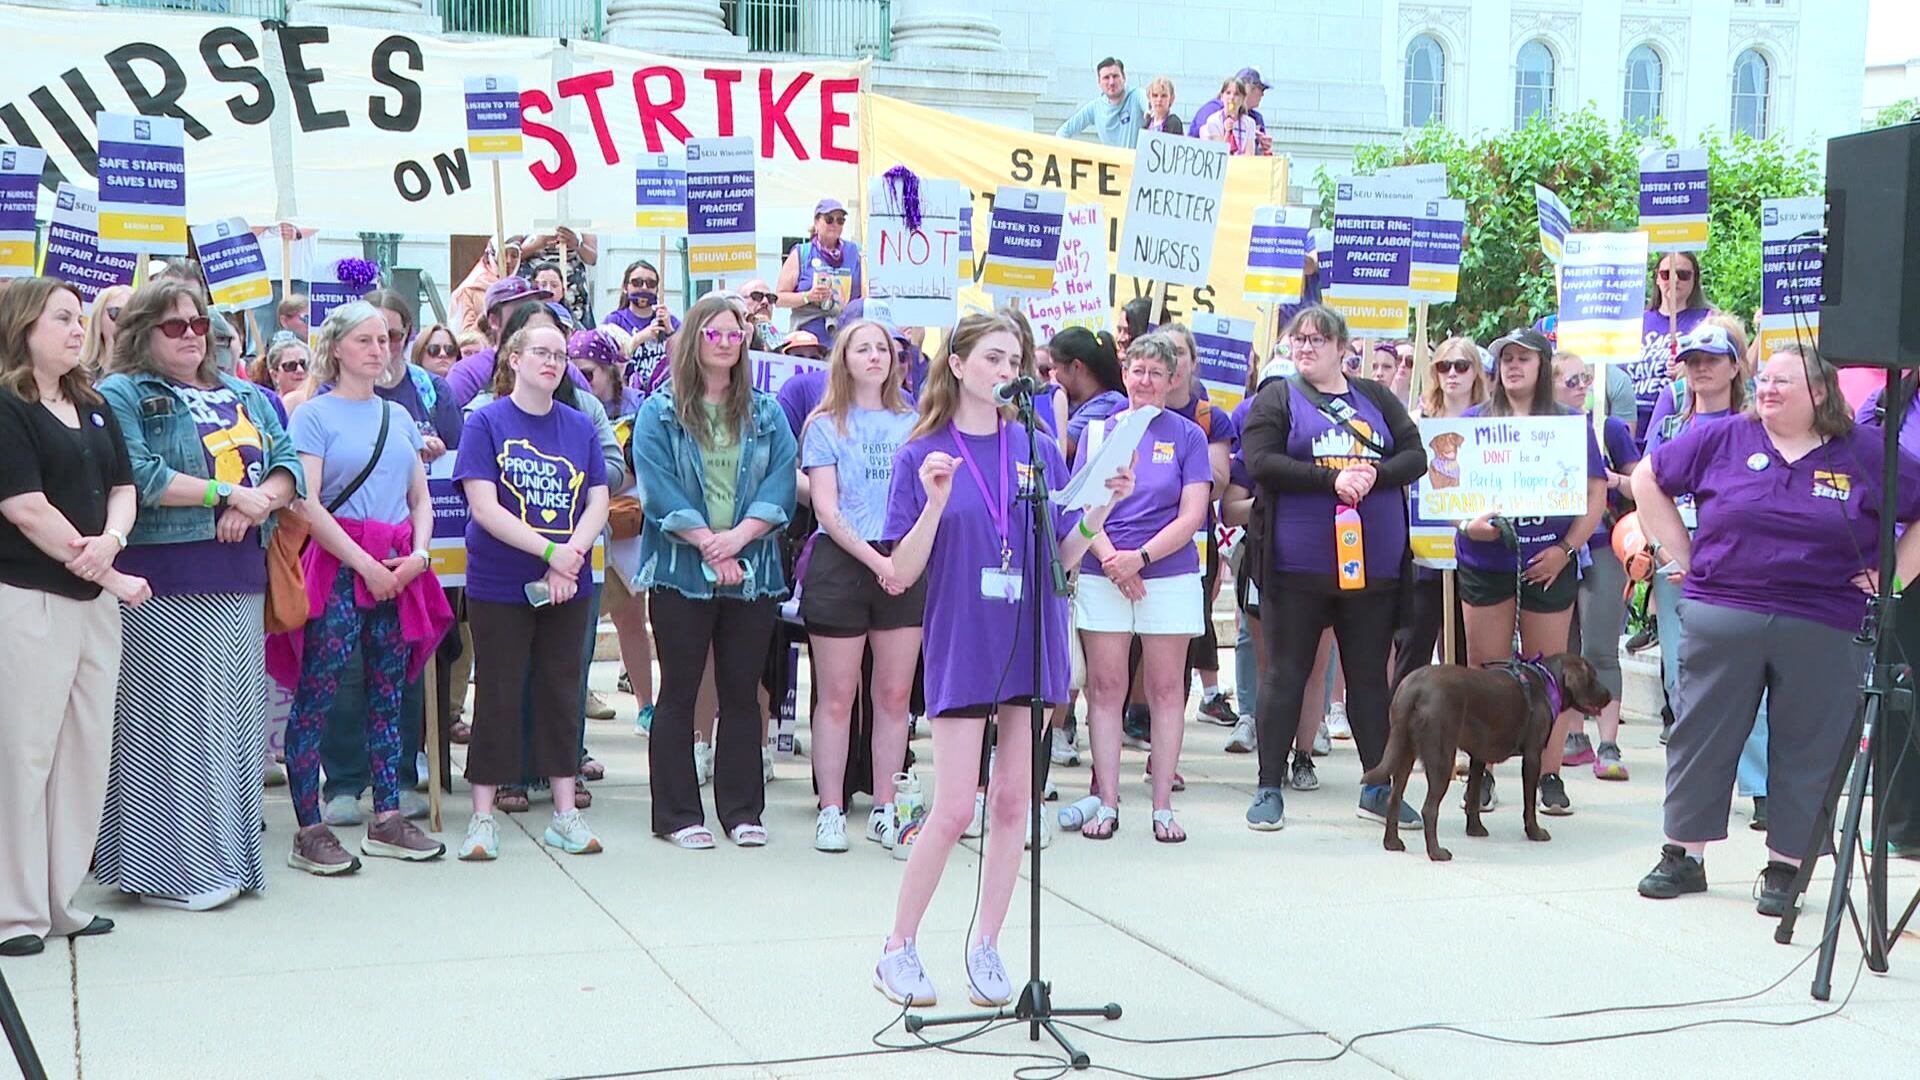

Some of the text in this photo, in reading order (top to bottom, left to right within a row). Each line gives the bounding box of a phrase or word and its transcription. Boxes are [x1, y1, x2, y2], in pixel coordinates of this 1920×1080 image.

[493, 101, 504, 109] TO
[505, 101, 521, 109] THE
[518, 65, 860, 192] STRIKE
[99, 157, 184, 173] SAFE STAFFING
[1147, 139, 1228, 181] SUPPORT
[394, 148, 471, 202] ON
[1010, 147, 1121, 198] SAFE
[107, 175, 178, 190] SAVES LIVES
[636, 178, 662, 186] LISTEN
[664, 178, 673, 186] TO
[688, 174, 753, 185] MERITER RNs:
[1416, 176, 1445, 185] isconsin
[1640, 180, 1707, 192] LISTEN TO THE
[646, 189, 677, 197] NURSES
[688, 188, 754, 199] UNFAIR LABOR
[1353, 190, 1413, 199] SEIU Wisconsin
[1652, 194, 1690, 205] NURSES
[75, 203, 97, 214] SEIU
[699, 203, 744, 213] PRACTICE
[1135, 186, 1216, 224] MERITER
[705, 217, 739, 227] STRIKE
[1799, 212, 1825, 221] Wiscon
[992, 220, 1062, 236] LISTEN TO THE
[1336, 218, 1412, 231] MERITER RNs:
[51, 227, 99, 246] MERITE
[1335, 234, 1412, 247] UNFAIR LABOR
[1413, 231, 1429, 239] PECT
[880, 228, 959, 266] NOT
[1003, 236, 1043, 248] NURSES
[48, 243, 135, 270] UNFAIR LABOR
[202, 242, 260, 264] SAFE STAFFING
[692, 250, 753, 263] SEIUWI.ORG
[1133, 234, 1200, 273] NURSES
[1346, 250, 1399, 263] PRACTICE
[209, 254, 258, 273] SAVES LIVES
[1318, 260, 1334, 269] LIST
[59, 262, 119, 283] PRACTICE
[1352, 267, 1391, 279] STRIKE
[1564, 265, 1614, 277] MERITER
[65, 280, 100, 296] TRIK
[1066, 278, 1093, 295] How
[1562, 278, 1643, 290] UNFAIR LABOR
[312, 294, 343, 303] LISTEN
[345, 294, 358, 303] TO
[1109, 272, 1216, 317] IVES
[1575, 292, 1630, 303] PRACTICE
[1028, 302, 1061, 320] Long
[1581, 305, 1622, 315] STRIKE
[1634, 377, 1672, 395] IVES
[1475, 423, 1556, 448] Millie says
[1483, 450, 1541, 465] DONT be a
[504, 457, 557, 477] PROUD
[865, 467, 892, 480] PROF
[513, 474, 563, 492] UNION
[1468, 470, 1549, 491] Party Pooper
[526, 490, 571, 509] NURSE
[1425, 492, 1486, 515] STAND
[432, 508, 466, 518] ATIENTS
